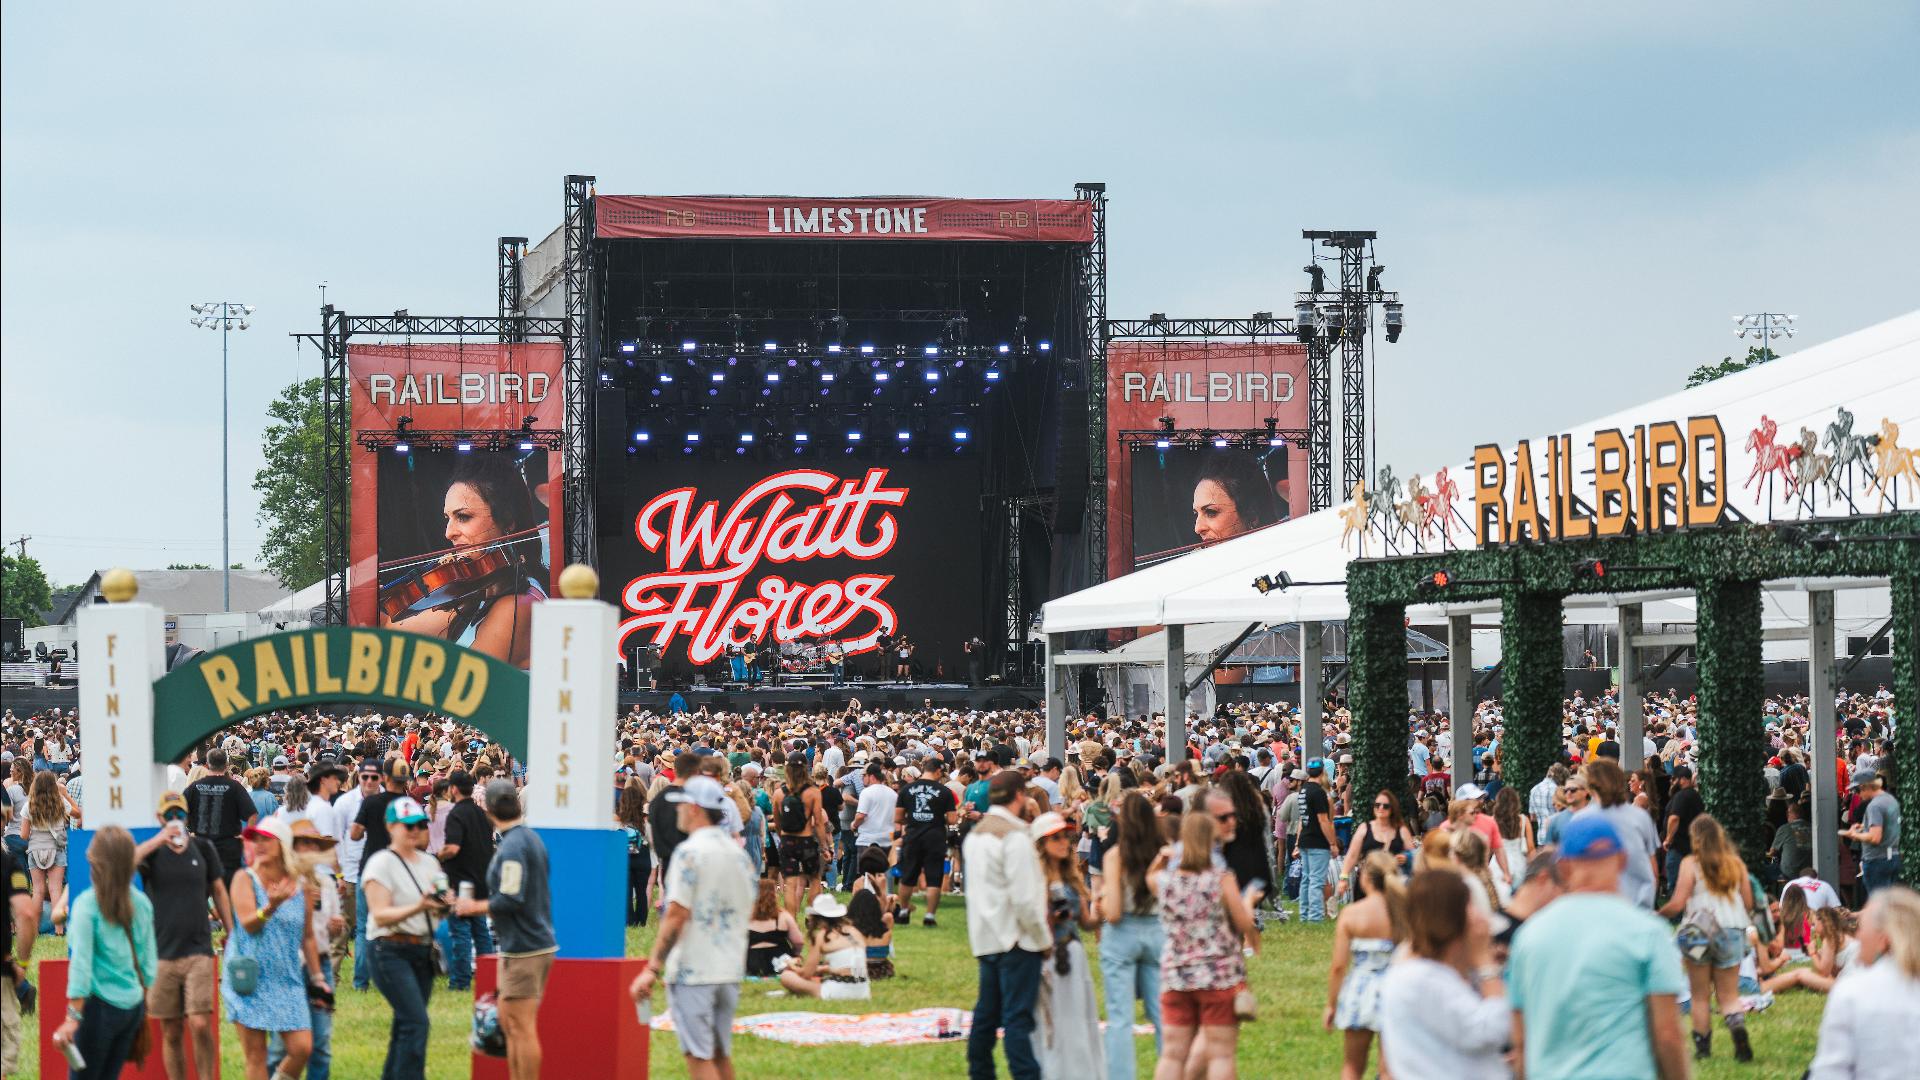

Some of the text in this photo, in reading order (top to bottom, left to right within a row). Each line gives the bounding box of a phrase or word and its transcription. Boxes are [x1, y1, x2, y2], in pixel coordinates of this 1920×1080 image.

[665, 208, 697, 227] RB
[766, 206, 930, 234] LIMESTONE
[999, 211, 1030, 229] RB
[368, 372, 550, 405] RAILBIRD
[1122, 371, 1295, 403] RAILBIRD
[635, 468, 910, 575] Wyatt
[1472, 414, 1728, 549] RAILBIRD
[617, 572, 898, 666] Flores
[200, 632, 489, 719] RAILBIRD
[556, 625, 574, 808] FINISH
[106, 633, 123, 809] FINISH
